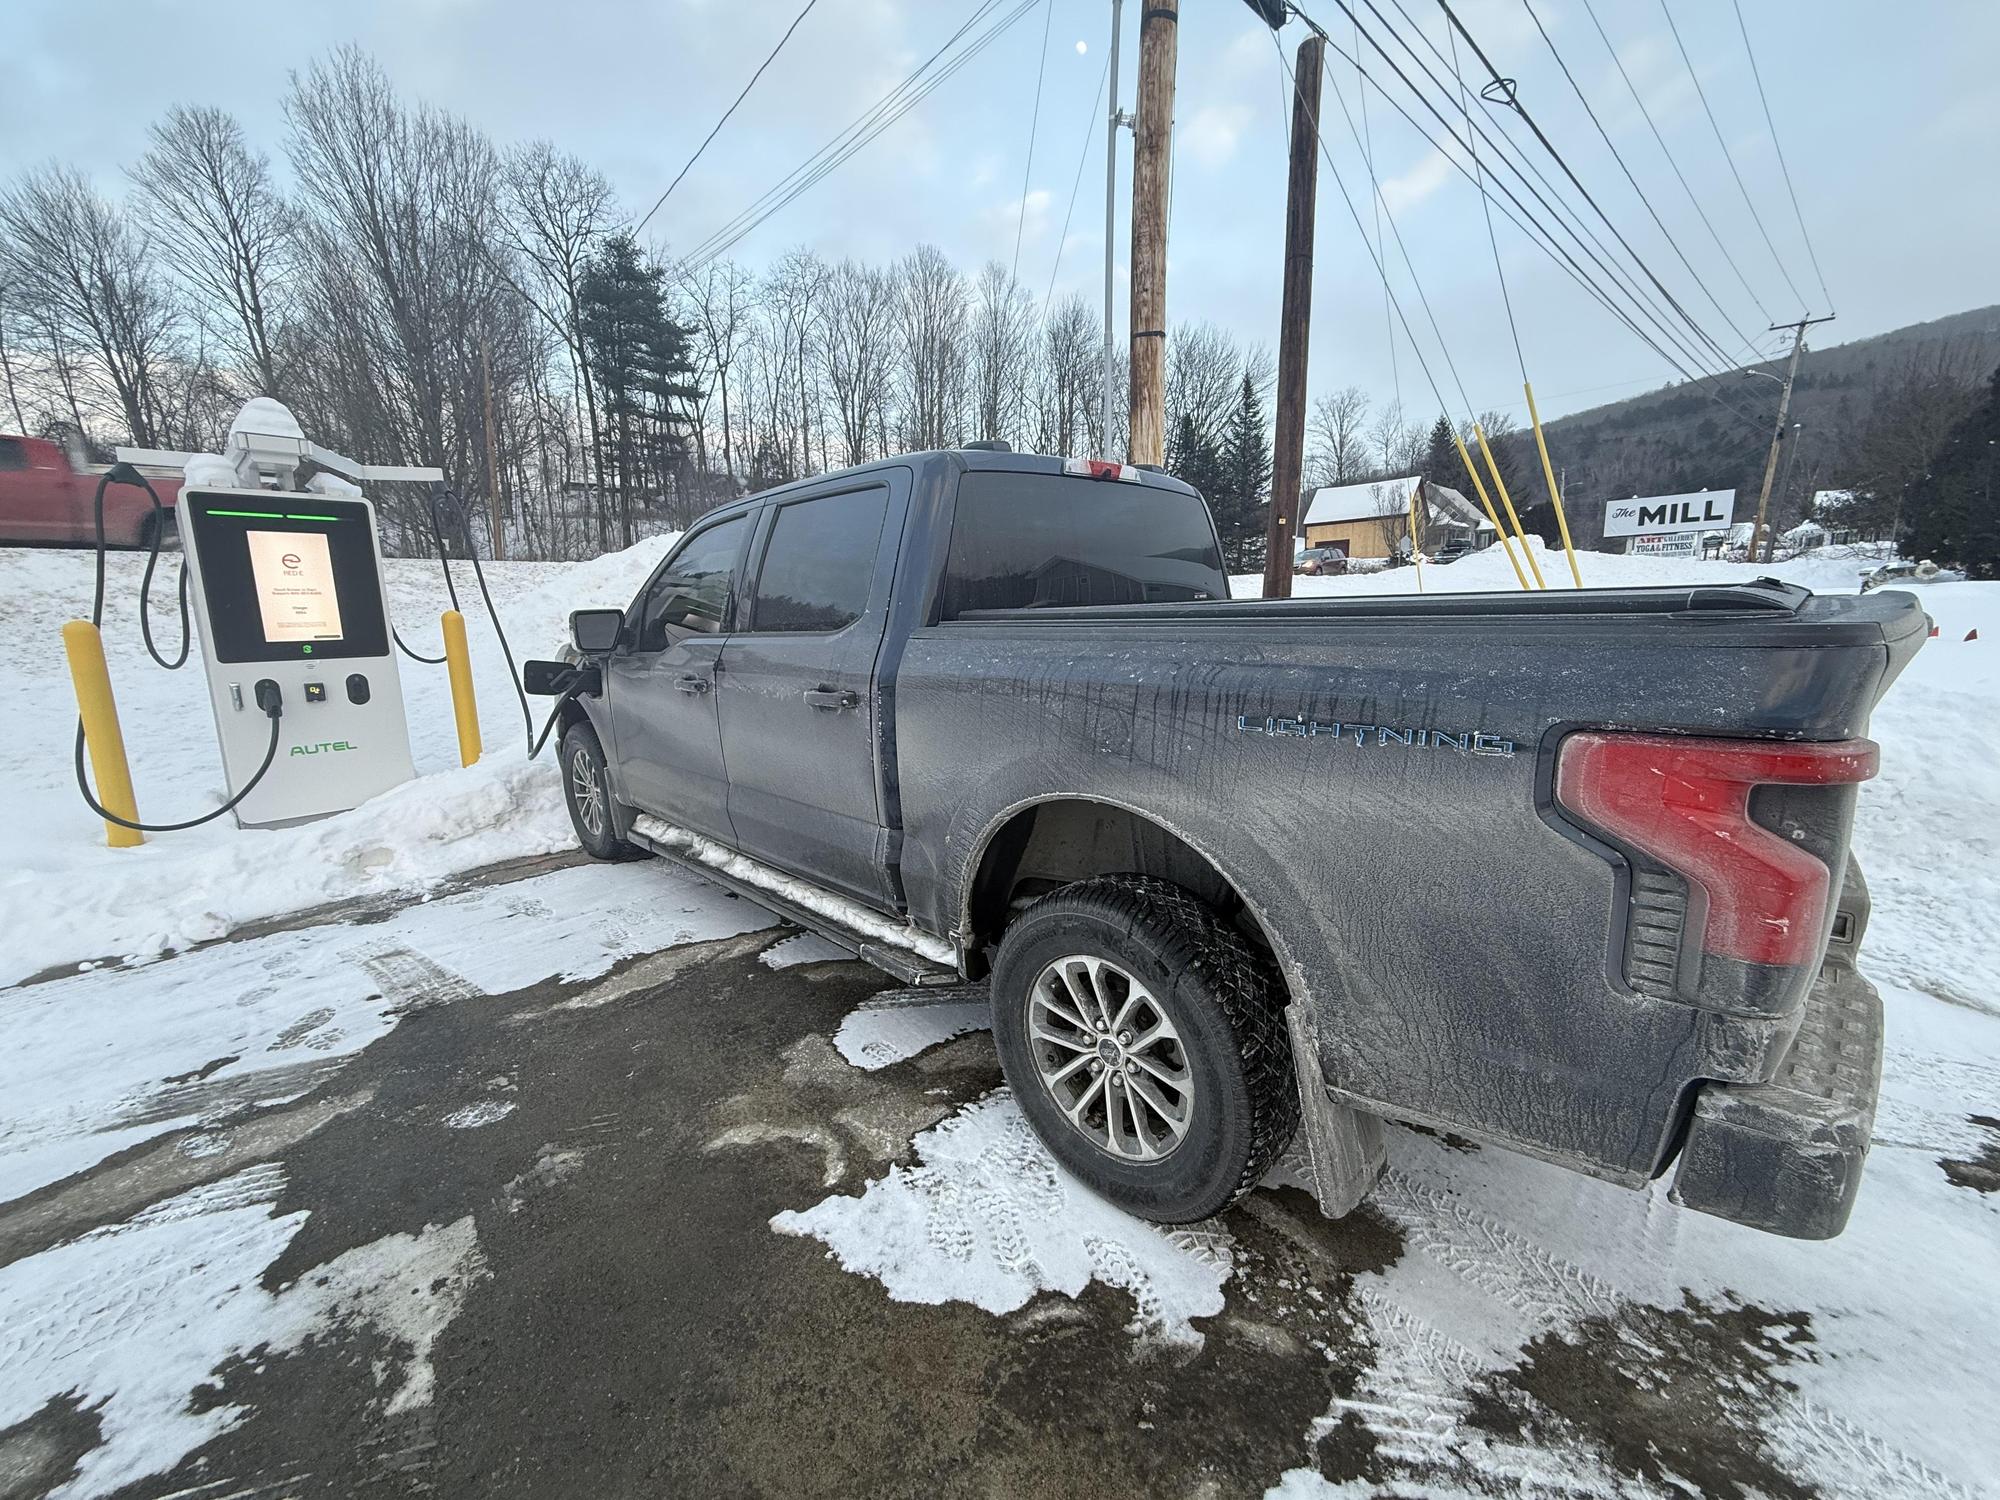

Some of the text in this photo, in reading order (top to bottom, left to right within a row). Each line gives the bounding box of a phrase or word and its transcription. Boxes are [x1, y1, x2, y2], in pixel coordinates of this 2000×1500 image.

[1612, 500, 1725, 526] The MILL
[1636, 544, 1655, 553] YOGA
[1661, 542, 1693, 552] FITNESS
[1637, 536, 1664, 544] ART
[1238, 716, 1513, 754] LIGHTNING
[290, 741, 358, 756] AUTEL
